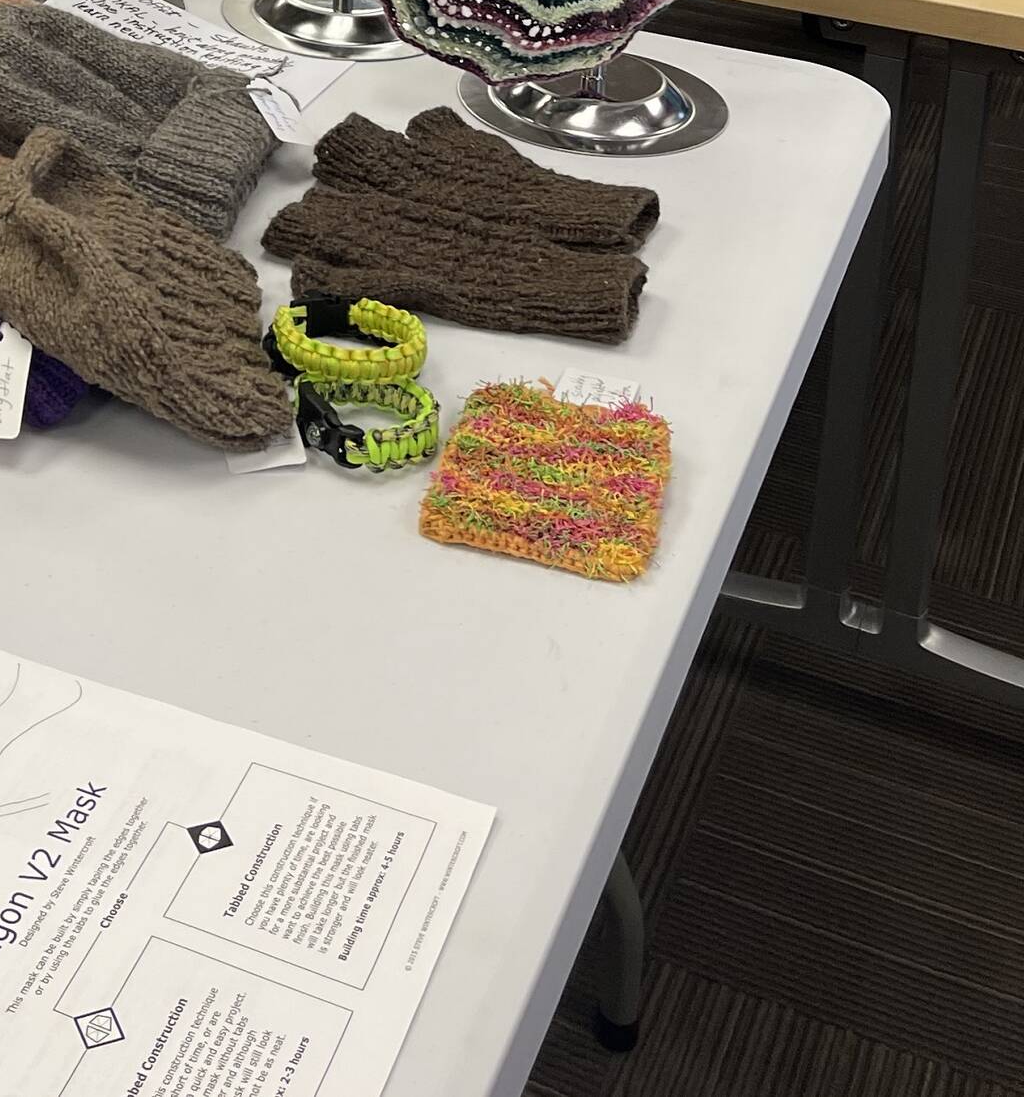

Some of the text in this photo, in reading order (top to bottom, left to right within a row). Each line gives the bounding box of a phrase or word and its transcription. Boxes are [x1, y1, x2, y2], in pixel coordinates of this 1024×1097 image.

[72, 1, 144, 40] learn new
[17, 847, 62, 881] V2
[45, 780, 108, 844] Mask
[221, 822, 283, 918] Tabbed Construction
[243, 794, 319, 927] Choose this construction technique if
[256, 802, 331, 932] you have plenty of time, are looking
[266, 812, 337, 936] for a more substantial project and
[280, 820, 348, 940] want to achieve the best possible
[3, 795, 148, 1014] This mask can be built by simply taping the edges together
[16, 834, 97, 948] Designed by Steve Wintercroft
[33, 819, 148, 996] or by using the tabs to glue the edges together.
[98, 891, 129, 929] Choose
[315, 839, 378, 955] is stronger and will look neater.
[336, 830, 405, 962] Building time approx: 4-5 hours
